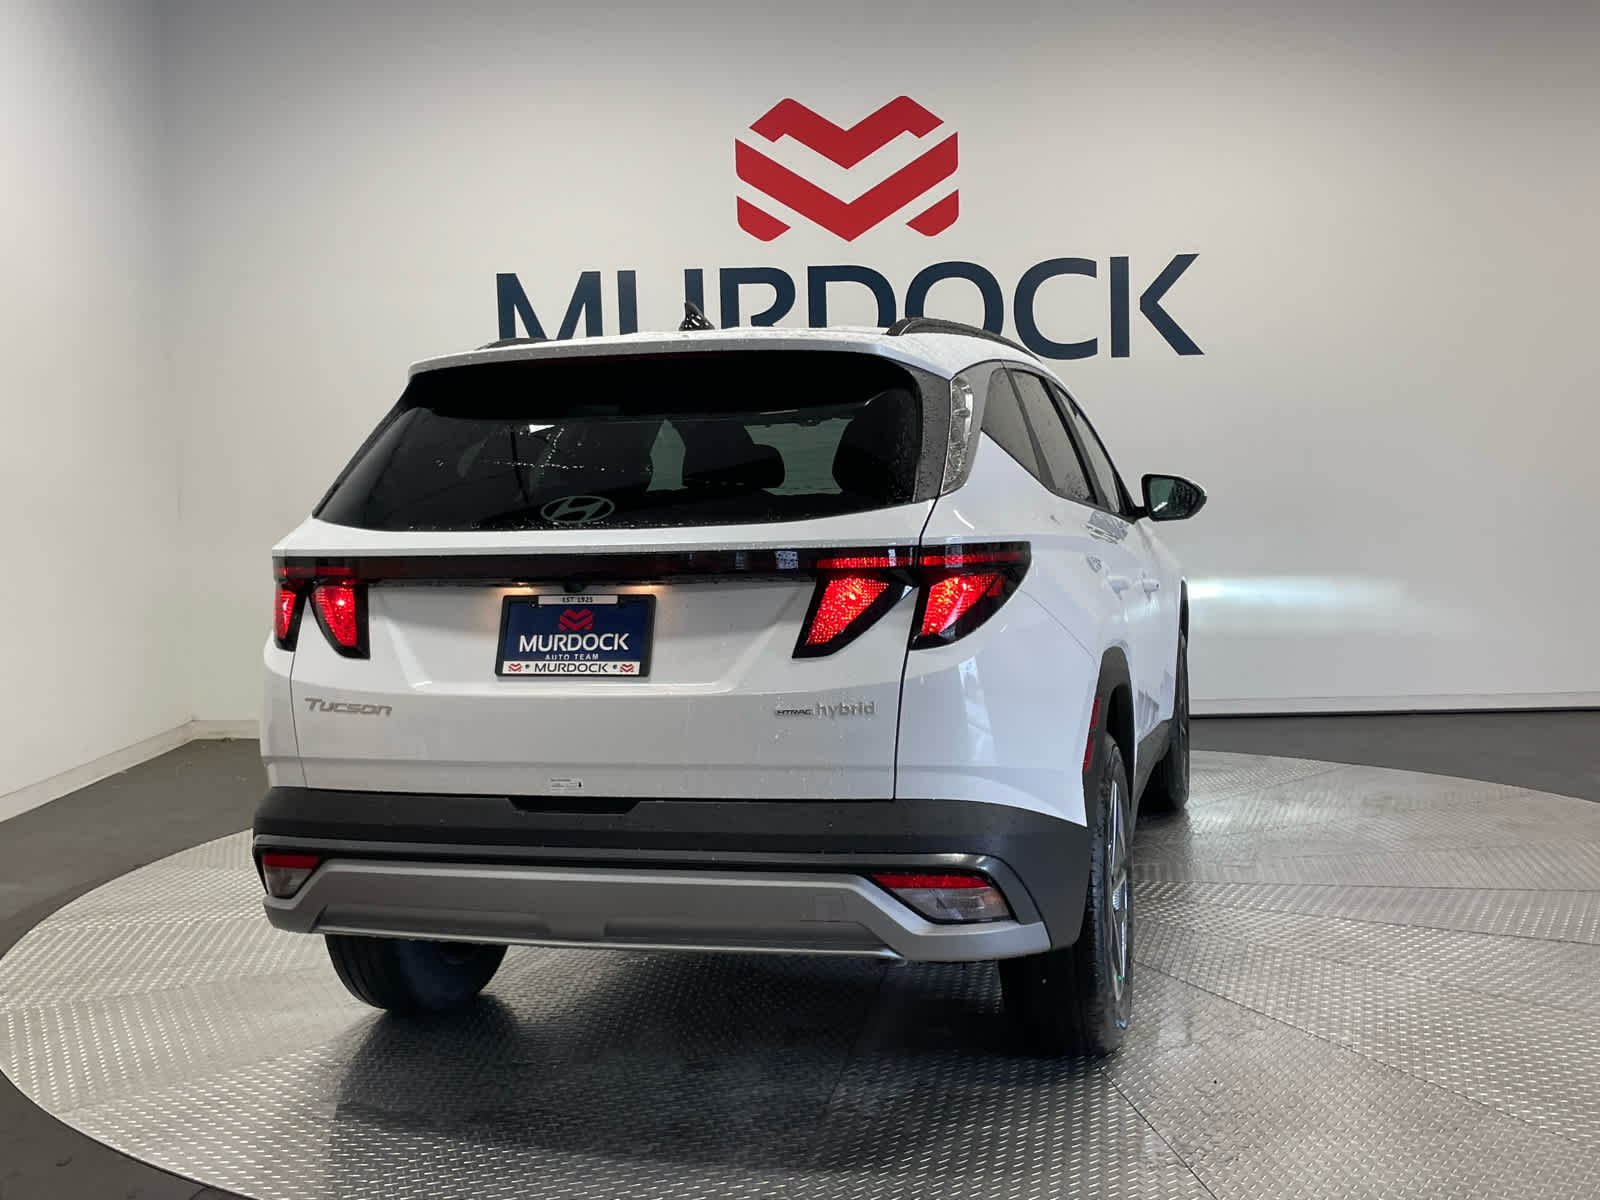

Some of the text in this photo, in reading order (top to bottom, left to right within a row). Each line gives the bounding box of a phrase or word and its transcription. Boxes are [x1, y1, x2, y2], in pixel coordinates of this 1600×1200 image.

[496, 254, 1205, 360] MURDOCK
[519, 633, 630, 652] MURDOCK
[545, 653, 599, 661] AUTO TEAM
[534, 663, 608, 673] MURDOCK
[816, 701, 875, 718] hybrid
